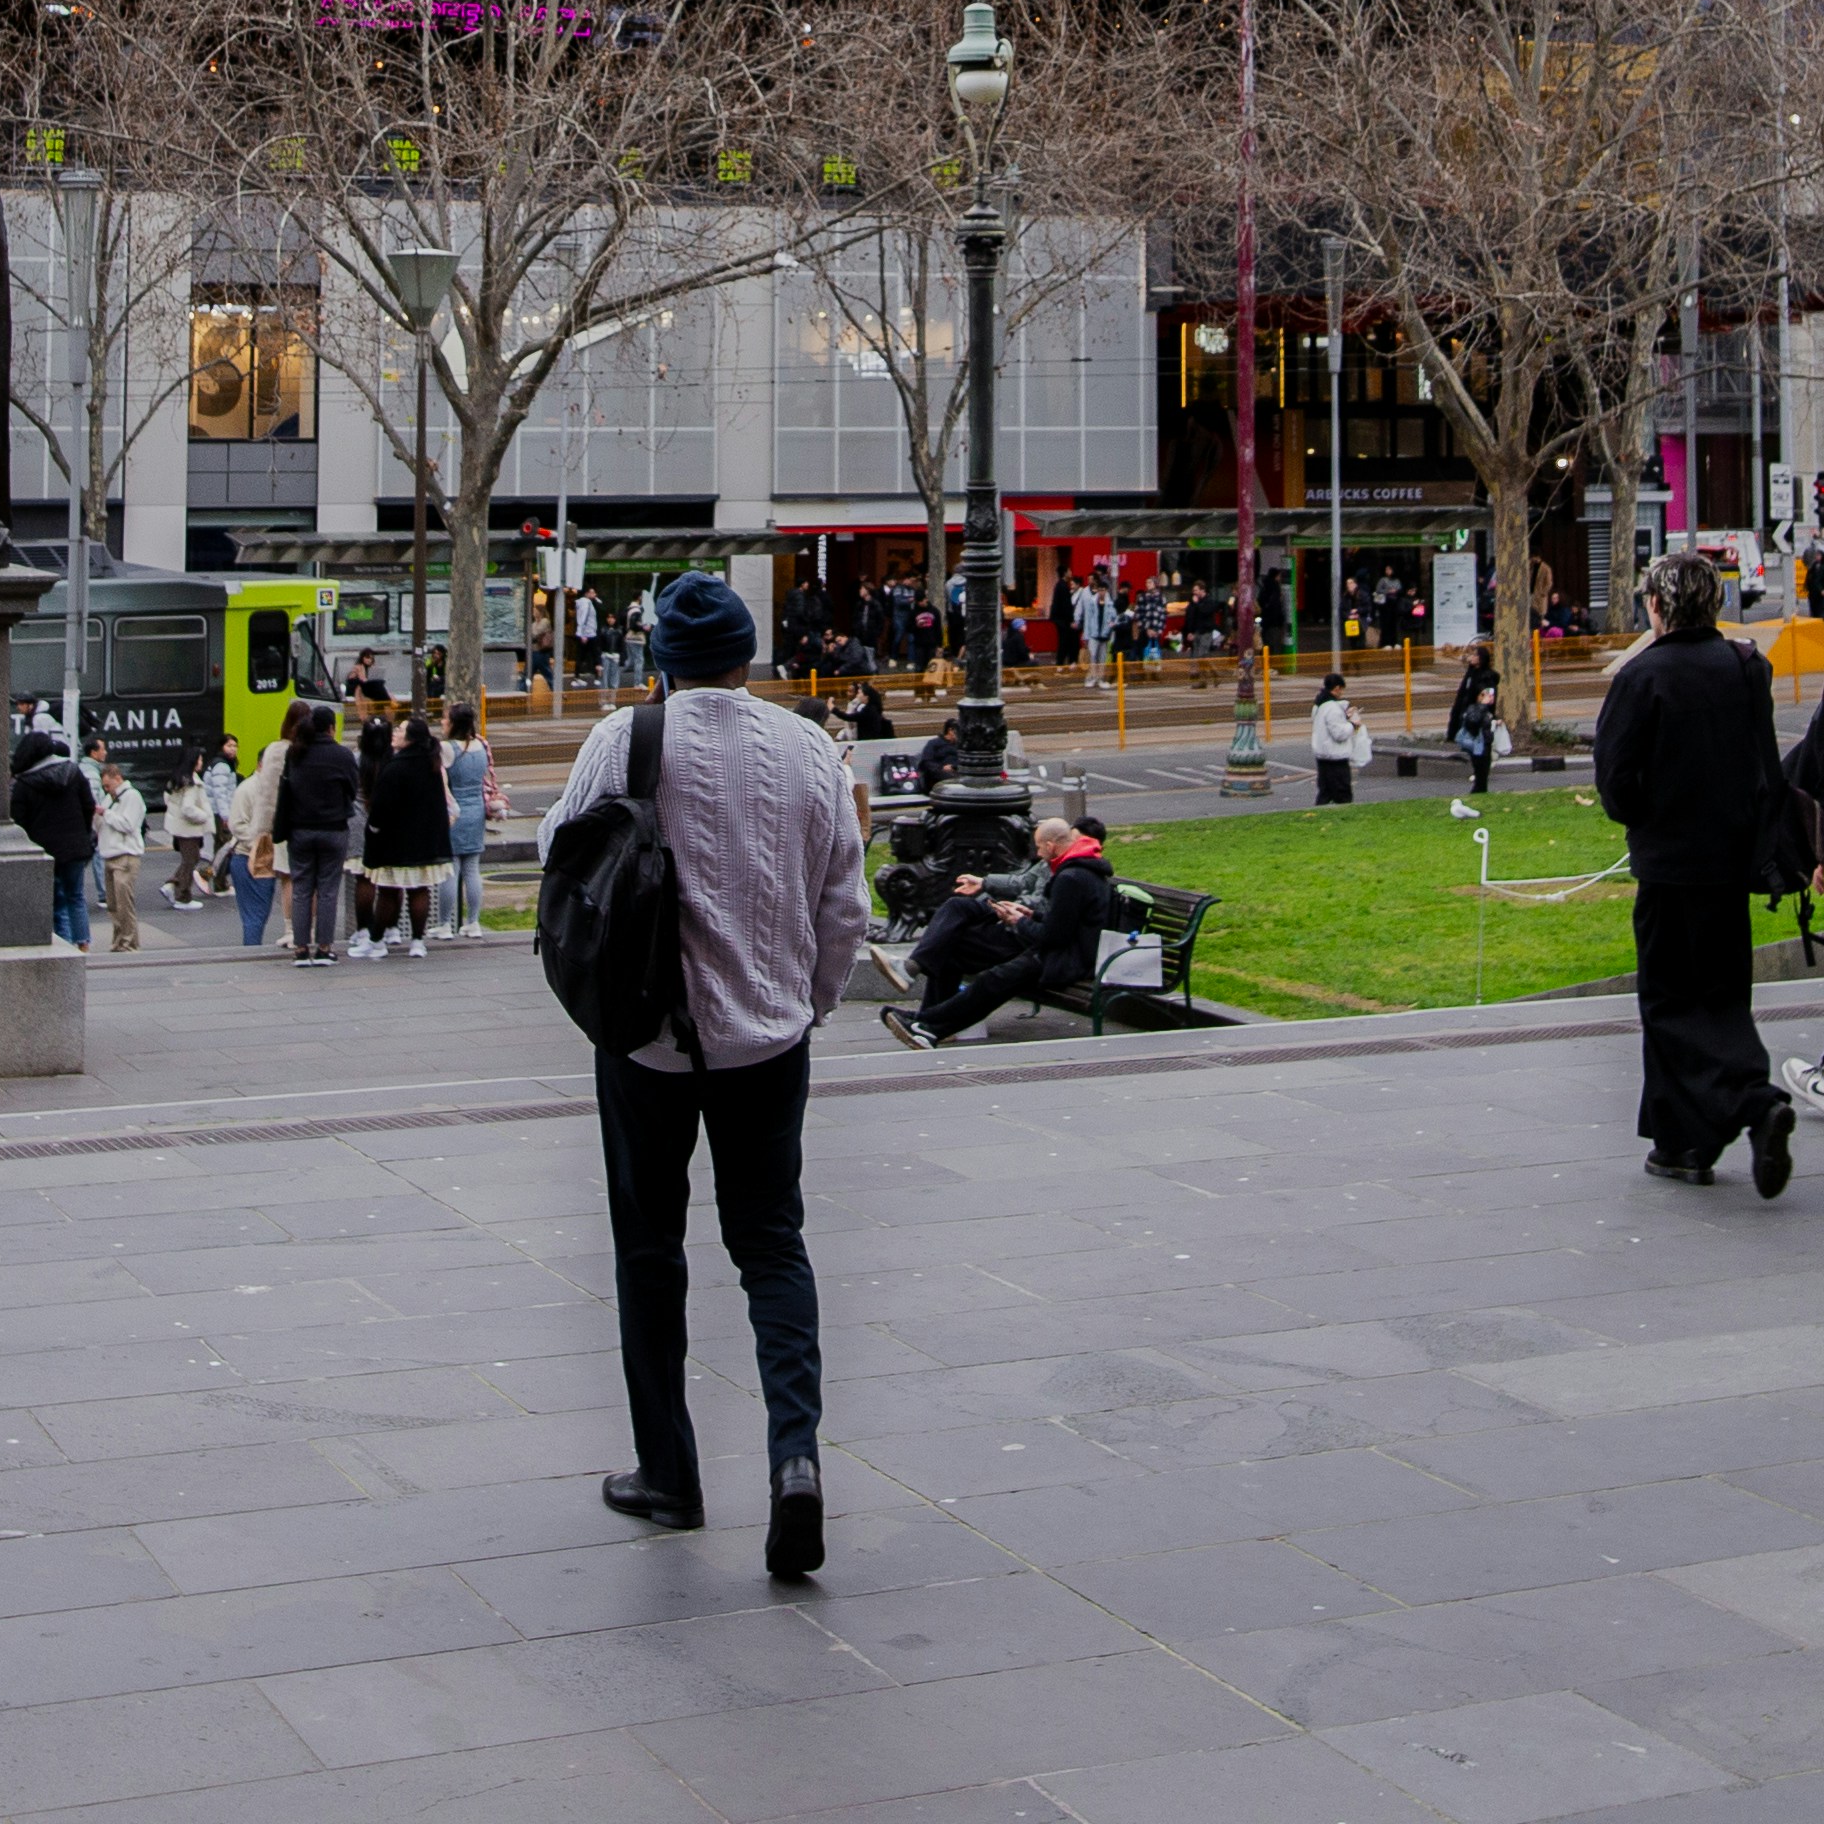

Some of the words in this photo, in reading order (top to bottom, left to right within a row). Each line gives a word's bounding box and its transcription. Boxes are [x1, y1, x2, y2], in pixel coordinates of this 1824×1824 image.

[1373, 487, 1423, 500] COFFEE
[108, 740, 138, 750] DOWN
[142, 738, 162, 748] FOR
[165, 737, 183, 747] AIR
